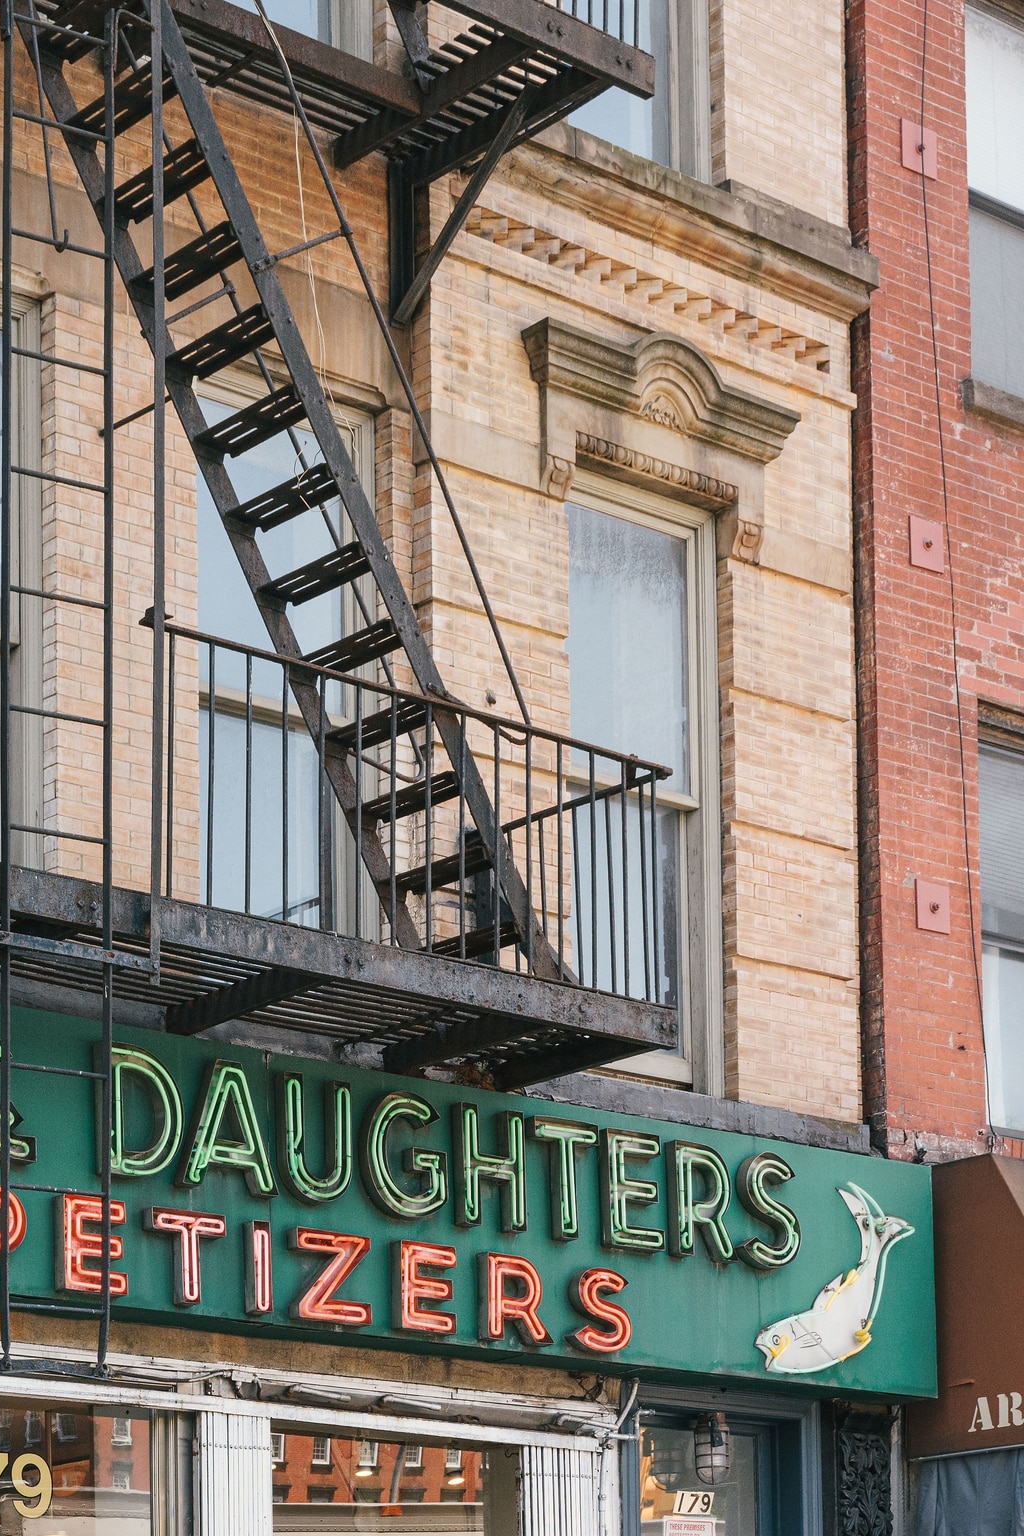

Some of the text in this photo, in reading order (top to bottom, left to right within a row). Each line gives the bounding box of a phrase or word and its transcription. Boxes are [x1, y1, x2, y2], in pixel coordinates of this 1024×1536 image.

[93, 1040, 804, 1271] DAUGHTERS
[967, 1391, 1024, 1433] AR
[677, 1492, 711, 1513] 179
[669, 1523, 706, 1532] THESE PREMISES
